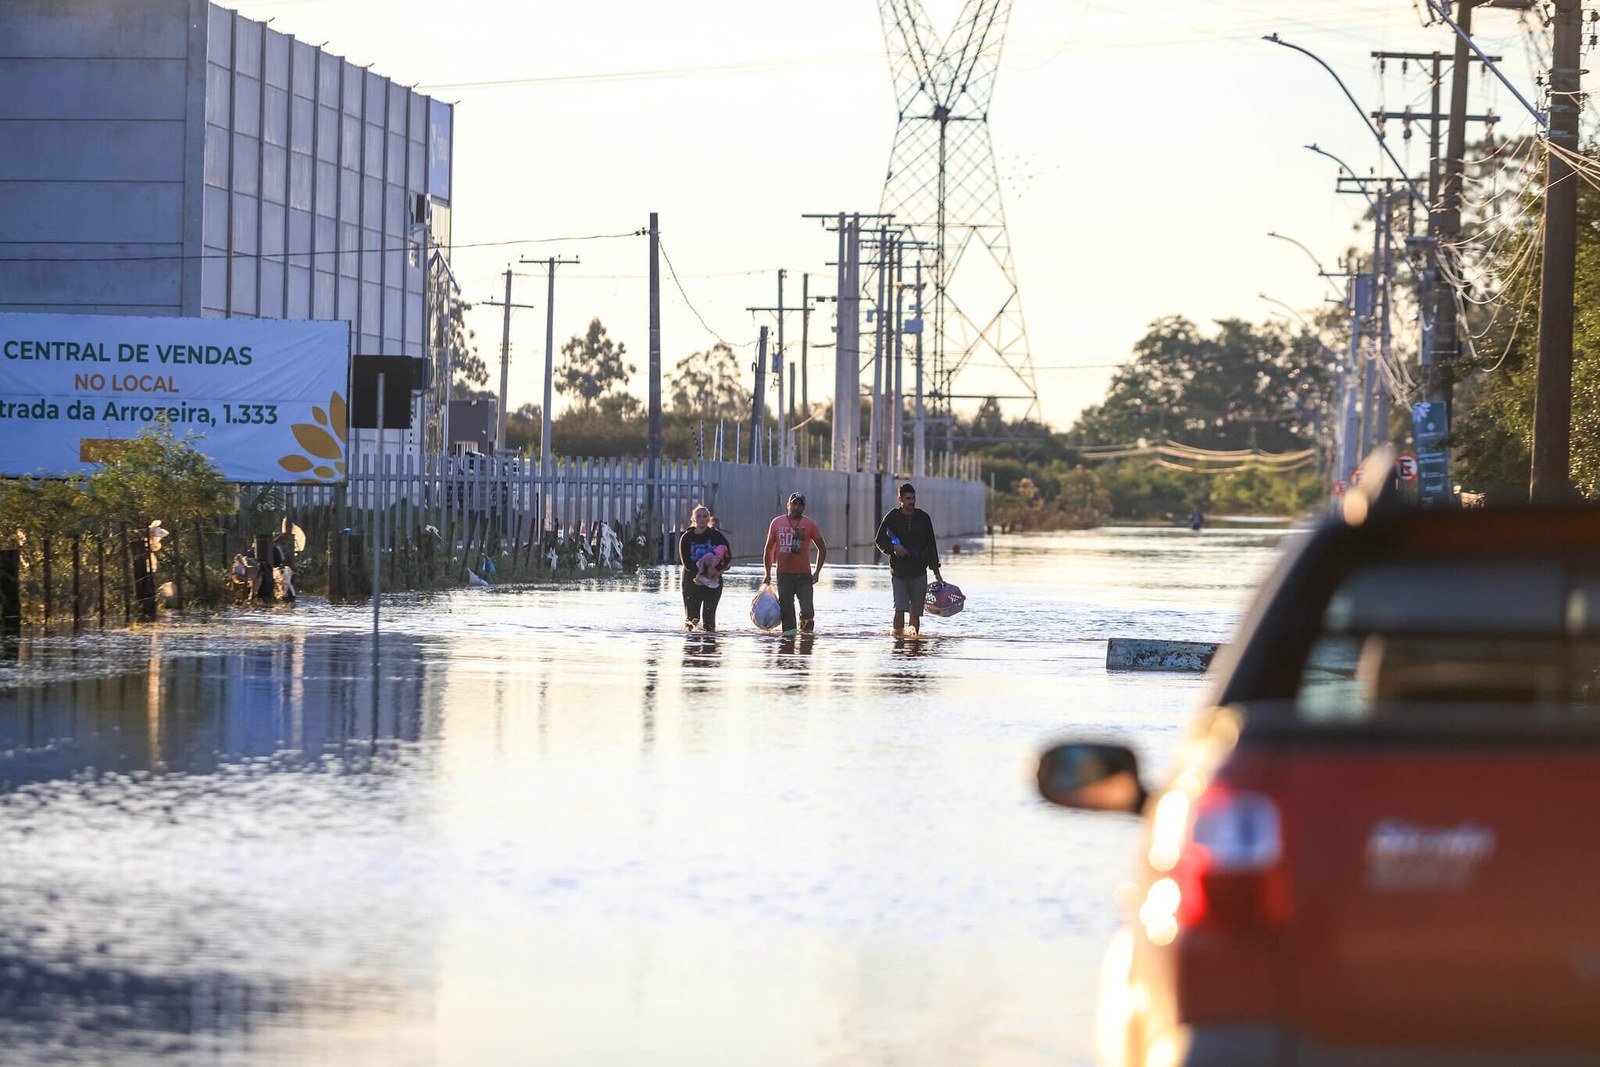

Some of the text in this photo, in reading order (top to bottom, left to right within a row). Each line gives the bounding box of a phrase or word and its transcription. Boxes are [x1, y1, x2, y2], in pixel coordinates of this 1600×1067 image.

[4, 340, 253, 366] CENTRAL DE VENDAS
[75, 373, 179, 393] NO LOCAL
[0, 399, 278, 428] trada da Arrozeira, 1.333
